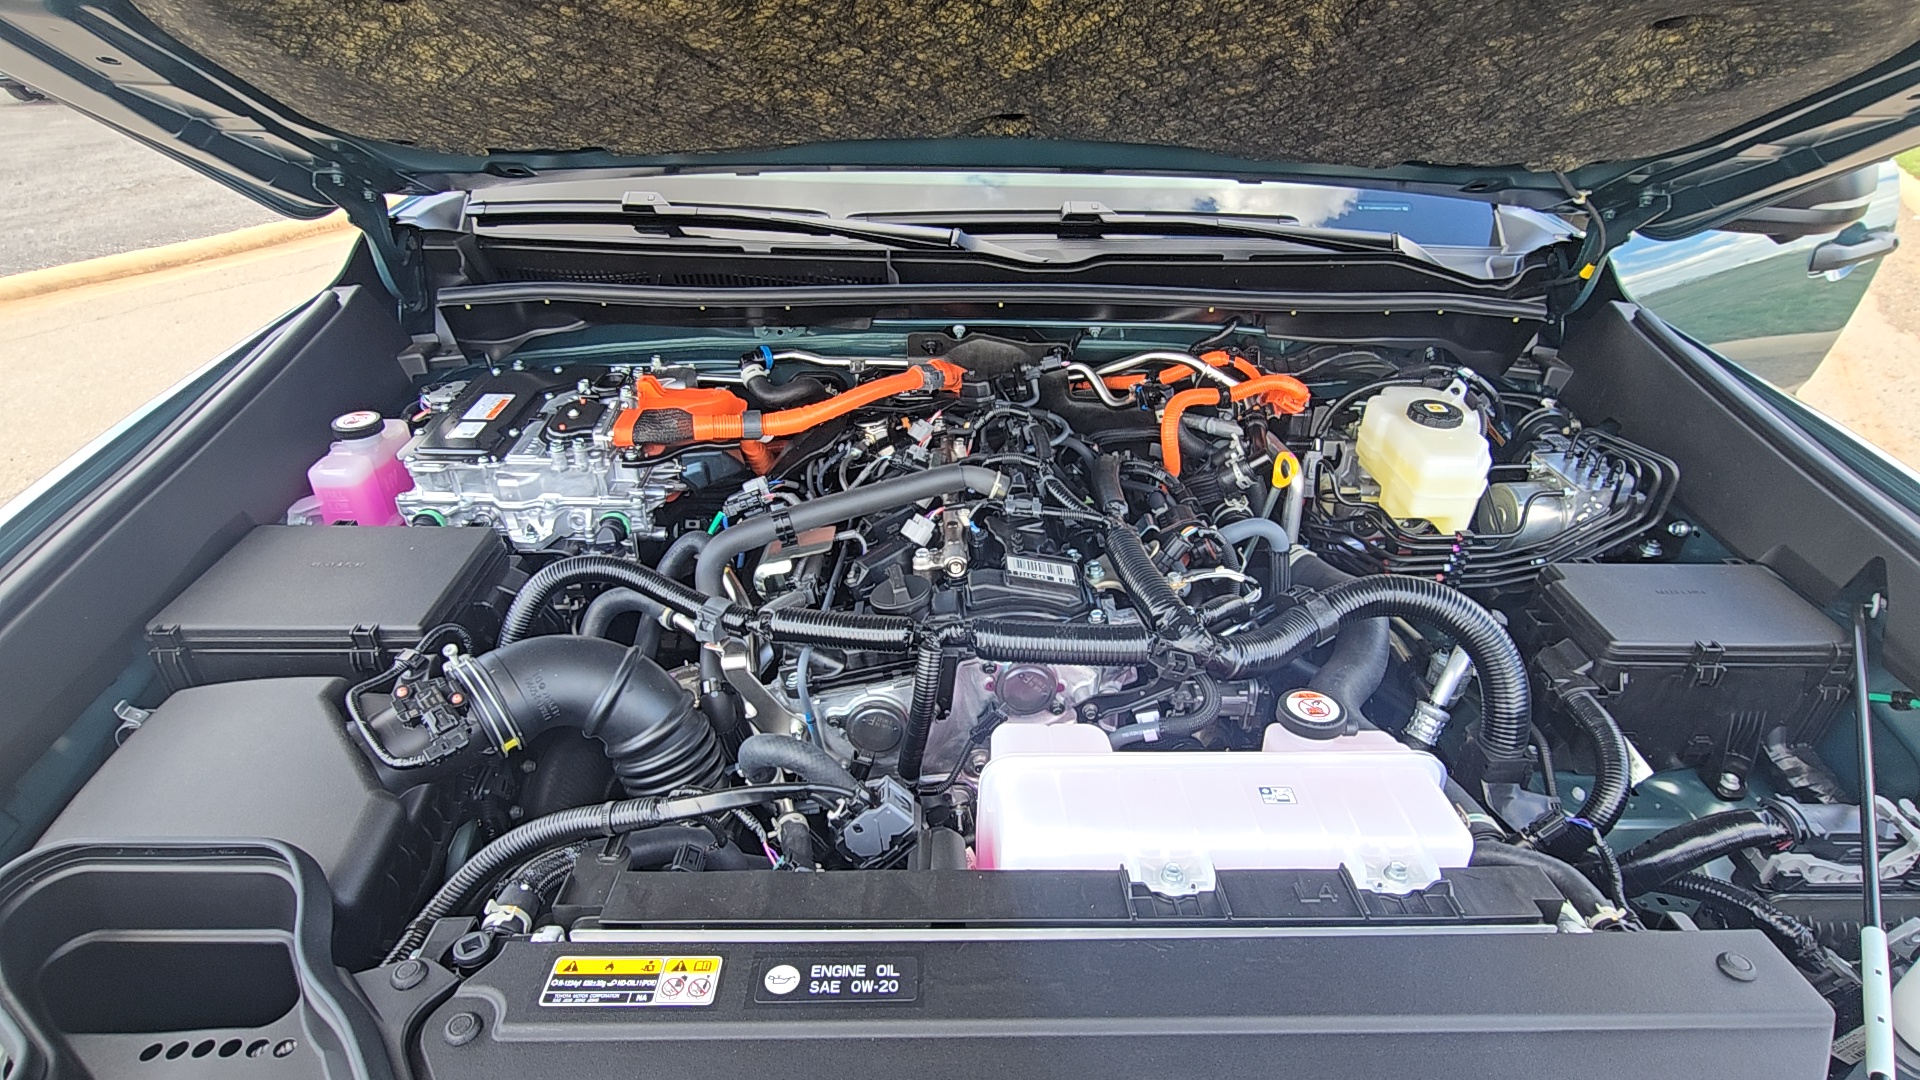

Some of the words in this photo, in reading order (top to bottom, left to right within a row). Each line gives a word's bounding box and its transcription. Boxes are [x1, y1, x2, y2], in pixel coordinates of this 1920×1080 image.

[810, 964, 867, 978] ENGINE
[875, 964, 900, 977] OIL
[809, 980, 842, 994] SAE
[850, 980, 899, 993] 0W-20
[635, 993, 647, 1002] NA
